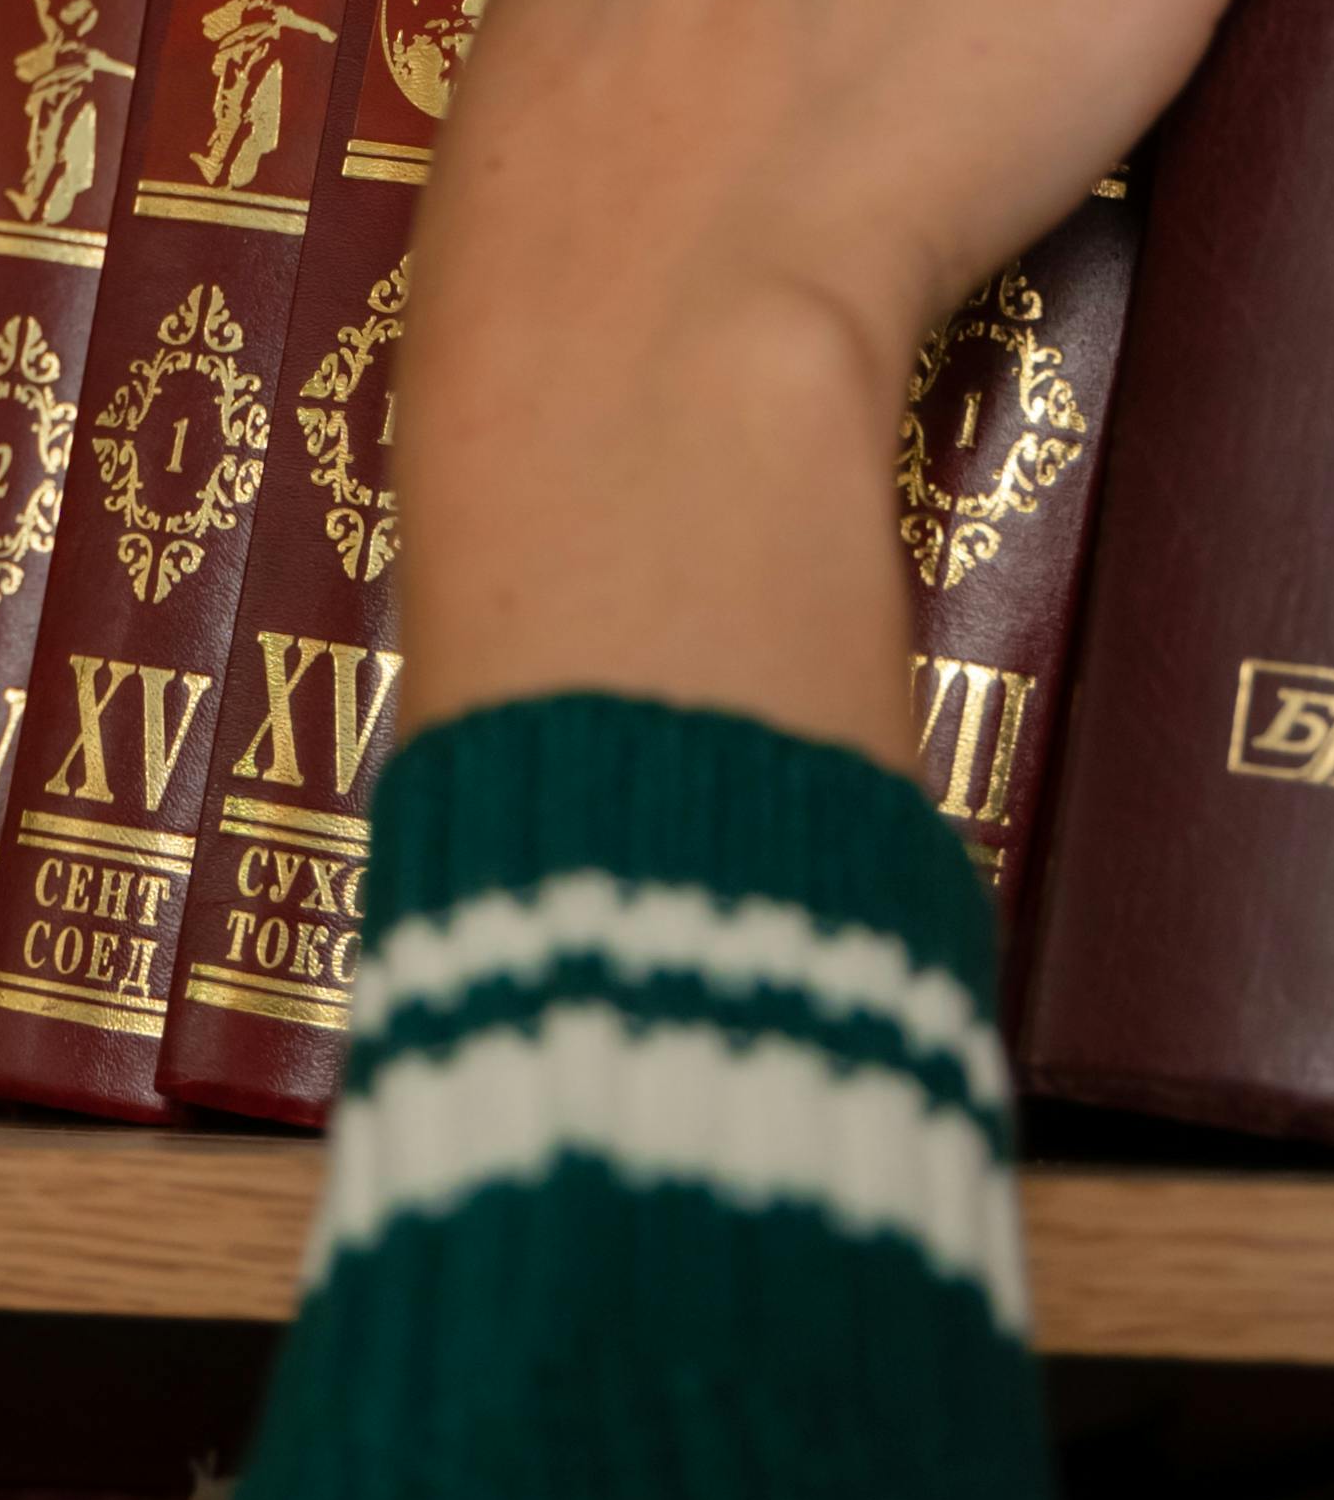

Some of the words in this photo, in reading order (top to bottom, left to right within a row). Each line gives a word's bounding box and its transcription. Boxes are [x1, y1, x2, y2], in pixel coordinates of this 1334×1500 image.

[165, 416, 190, 474] 1
[44, 653, 214, 813] XV
[34, 856, 170, 929] СЕНТ
[23, 922, 161, 997] СОЕД
